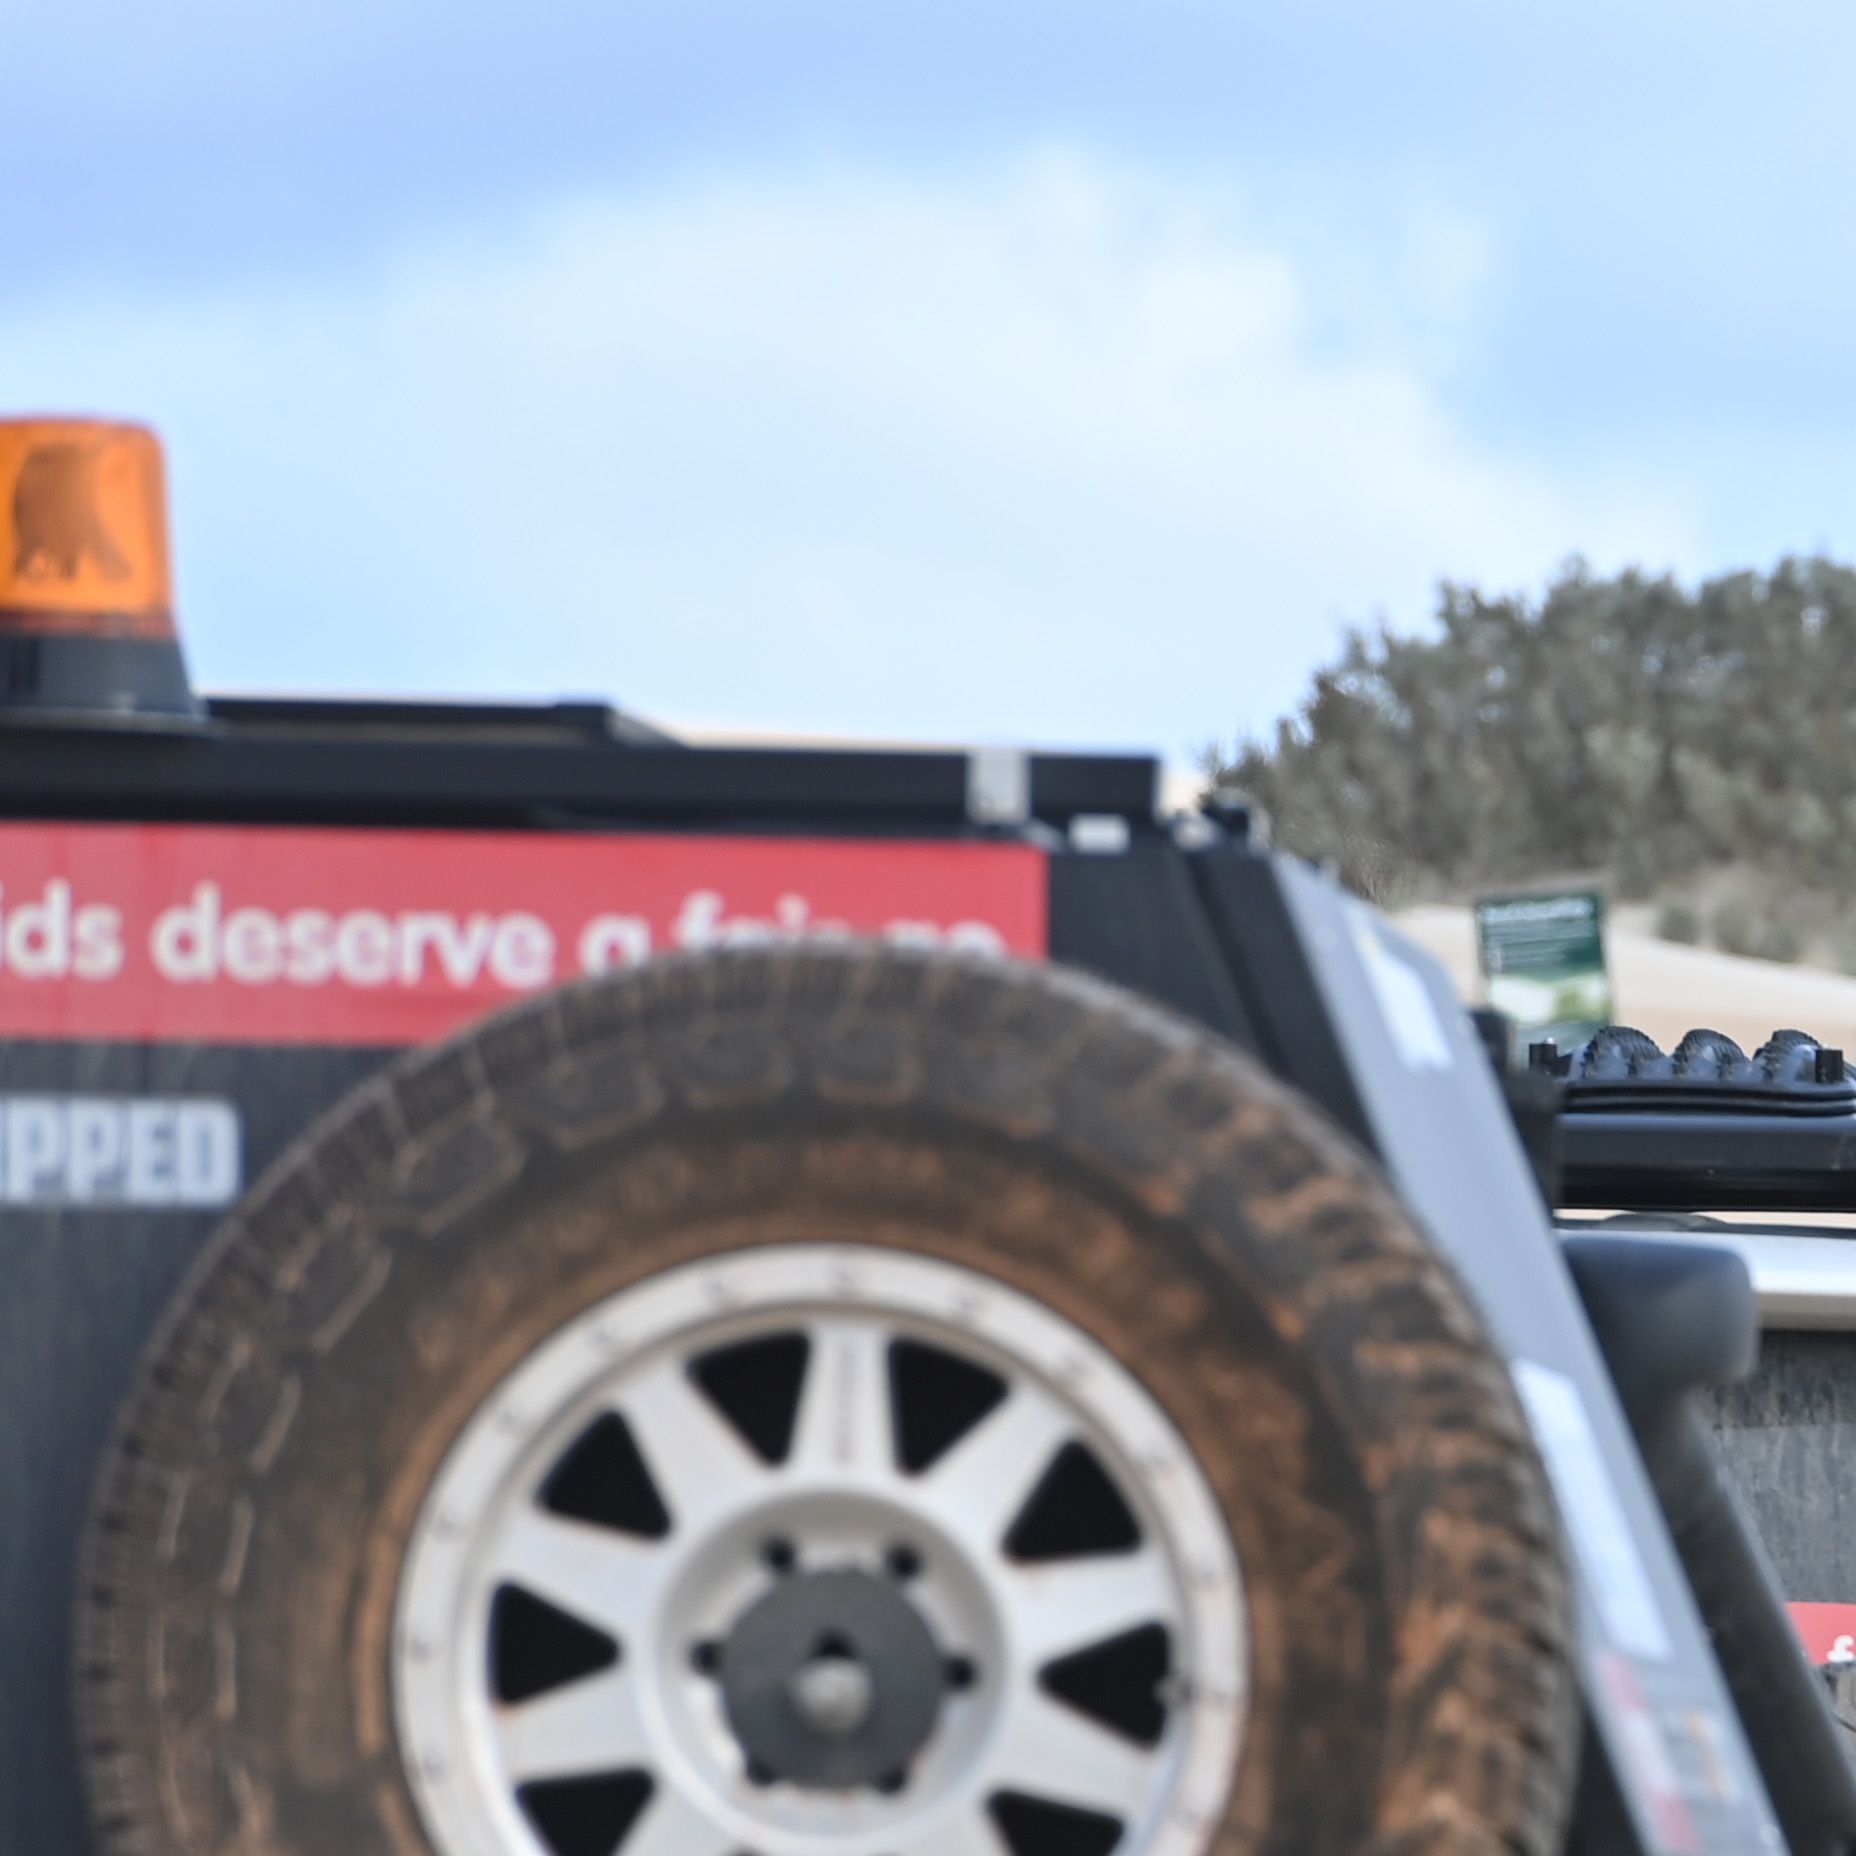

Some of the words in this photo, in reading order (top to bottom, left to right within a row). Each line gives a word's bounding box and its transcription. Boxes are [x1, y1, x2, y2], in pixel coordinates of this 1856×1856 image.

[0, 877, 125, 982] ds
[150, 881, 557, 990] deserve
[0, 1094, 242, 1207] PPED
